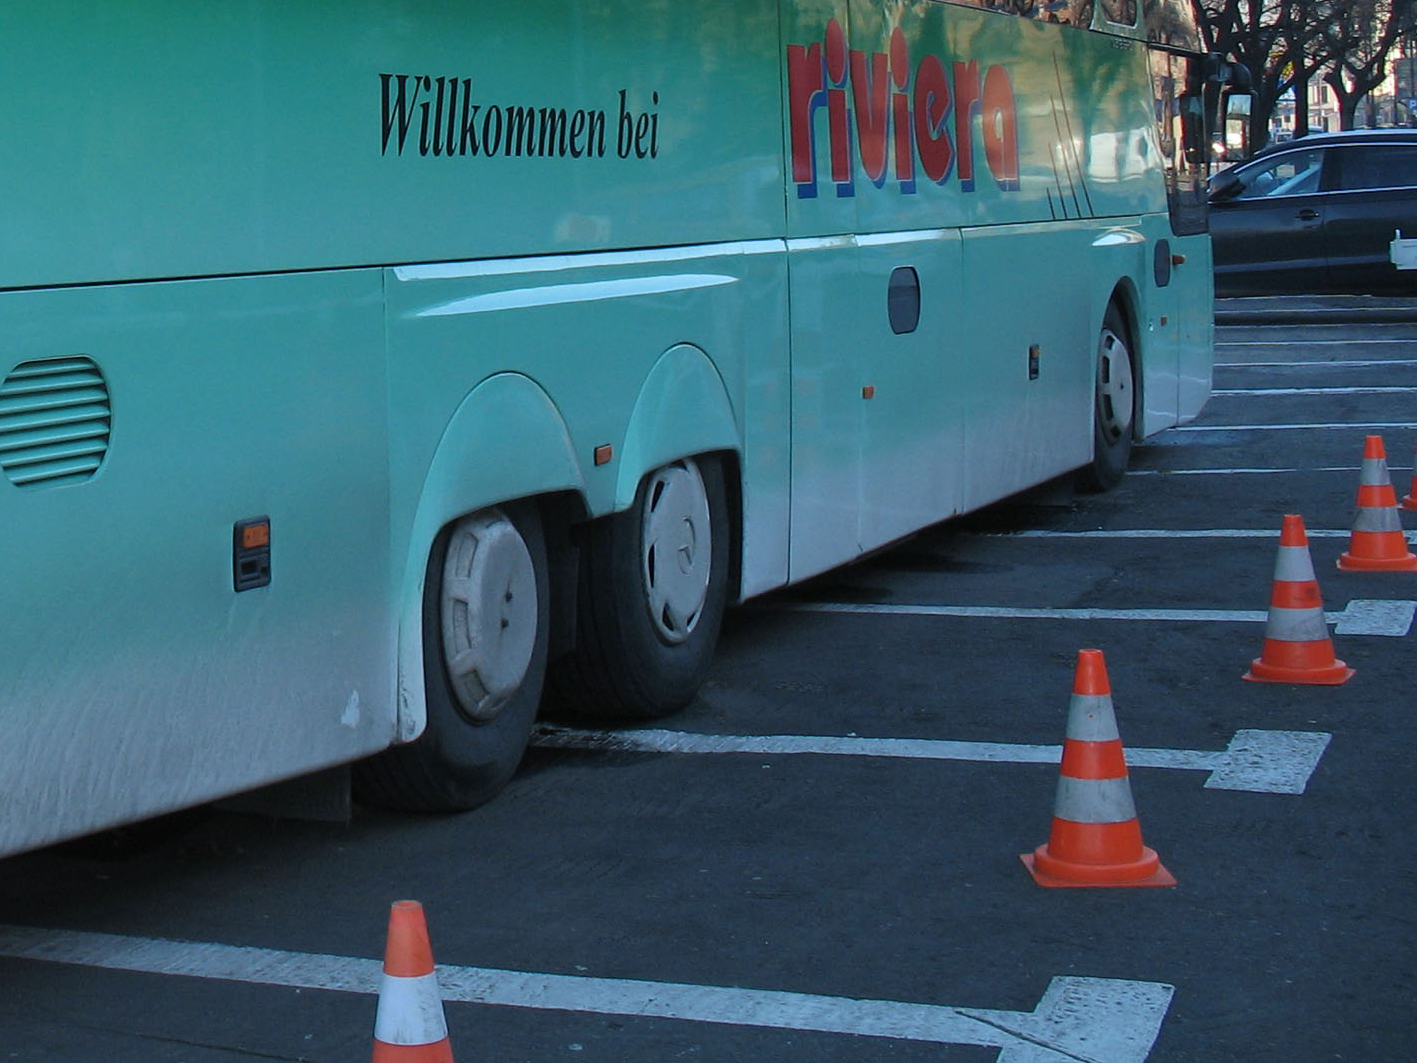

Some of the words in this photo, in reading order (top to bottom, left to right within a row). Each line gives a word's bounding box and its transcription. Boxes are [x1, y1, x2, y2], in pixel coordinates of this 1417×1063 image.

[379, 72, 606, 159] Willkommen
[616, 89, 660, 160] bei
[786, 18, 1020, 199] riviera
